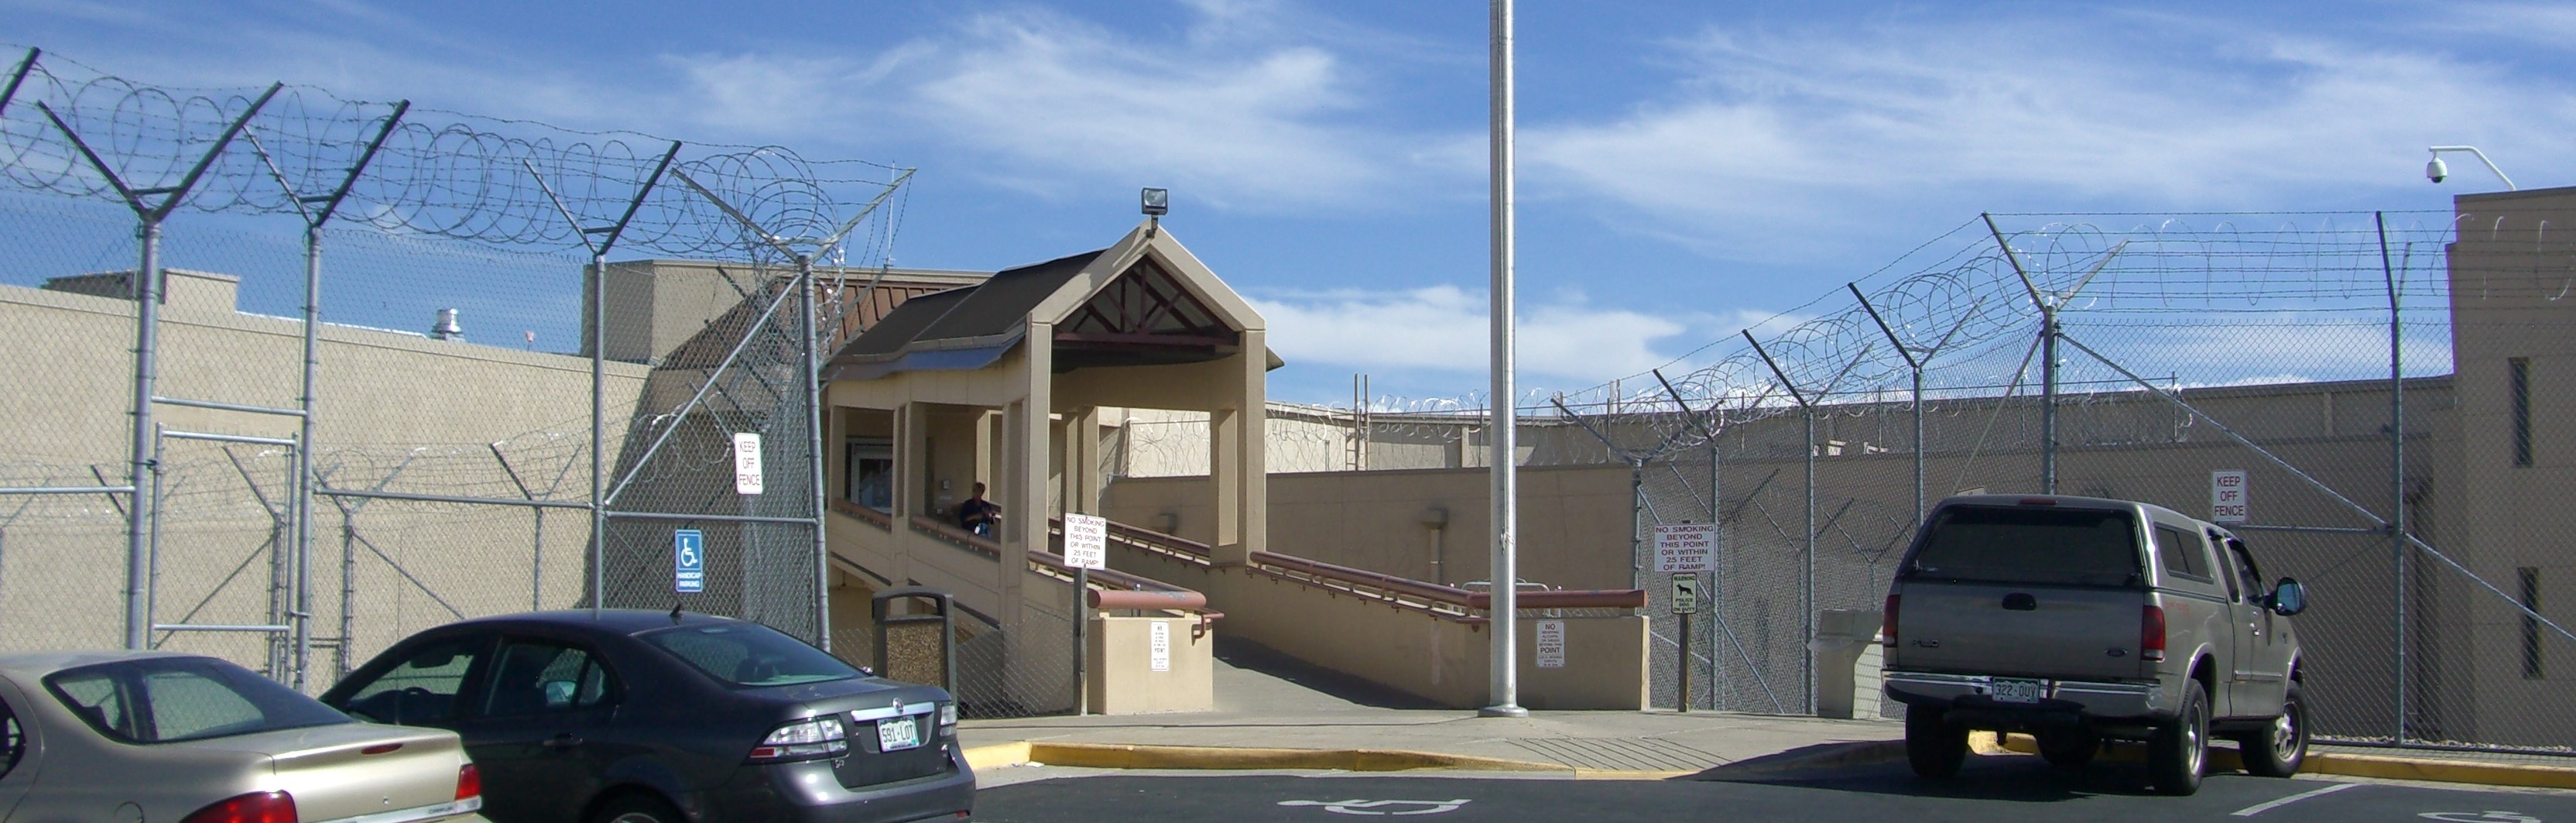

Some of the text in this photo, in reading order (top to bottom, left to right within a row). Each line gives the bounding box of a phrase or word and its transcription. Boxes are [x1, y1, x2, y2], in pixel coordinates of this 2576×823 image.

[739, 441, 755, 452] KEEP
[742, 458, 755, 468] OFF
[738, 474, 761, 485] FENCE
[2217, 476, 2241, 487] KEEP
[2220, 491, 2238, 502] OFF
[2214, 505, 2244, 516] FENCE
[1078, 518, 1105, 526] SMOKING
[1074, 526, 1097, 534] BEYOND
